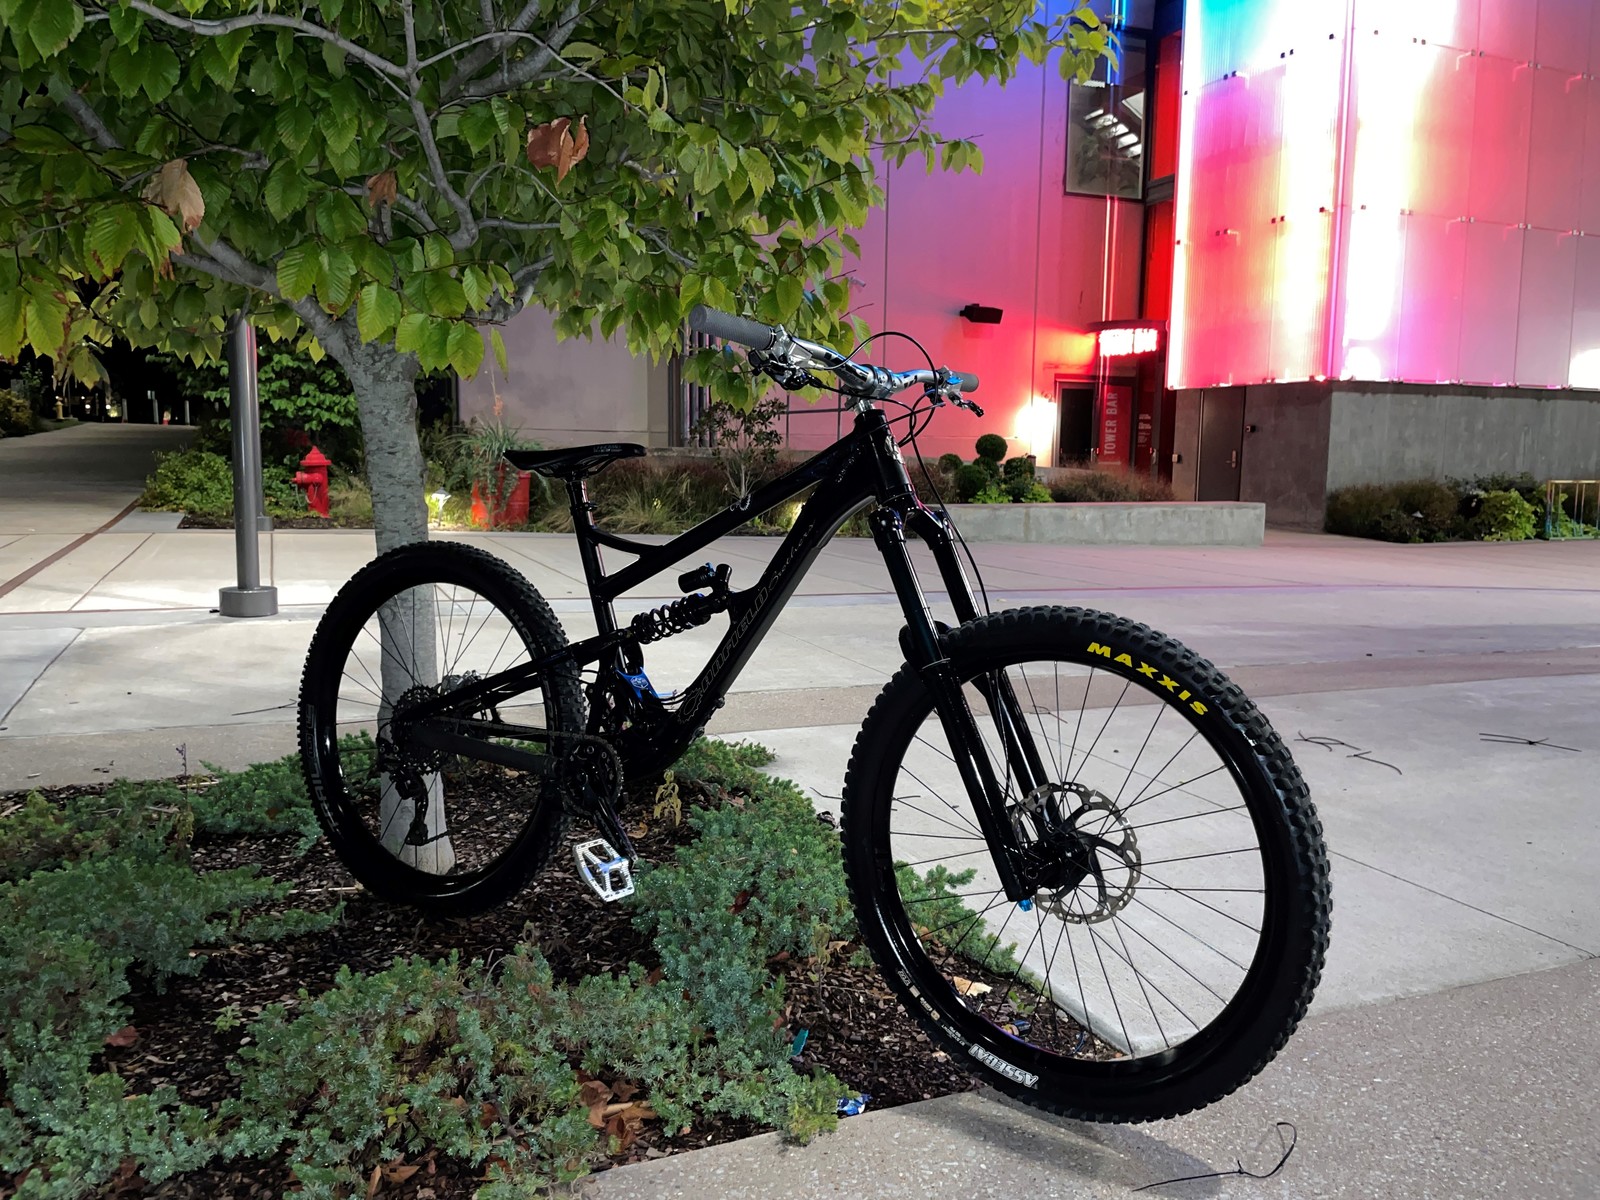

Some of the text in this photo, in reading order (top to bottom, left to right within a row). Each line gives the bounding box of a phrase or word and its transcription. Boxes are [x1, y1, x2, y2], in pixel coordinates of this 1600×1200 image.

[1104, 392, 1118, 455] TOWER BAR
[1087, 642, 1208, 715] MAXXIS
[968, 1043, 1039, 1087] ASSEGAI
